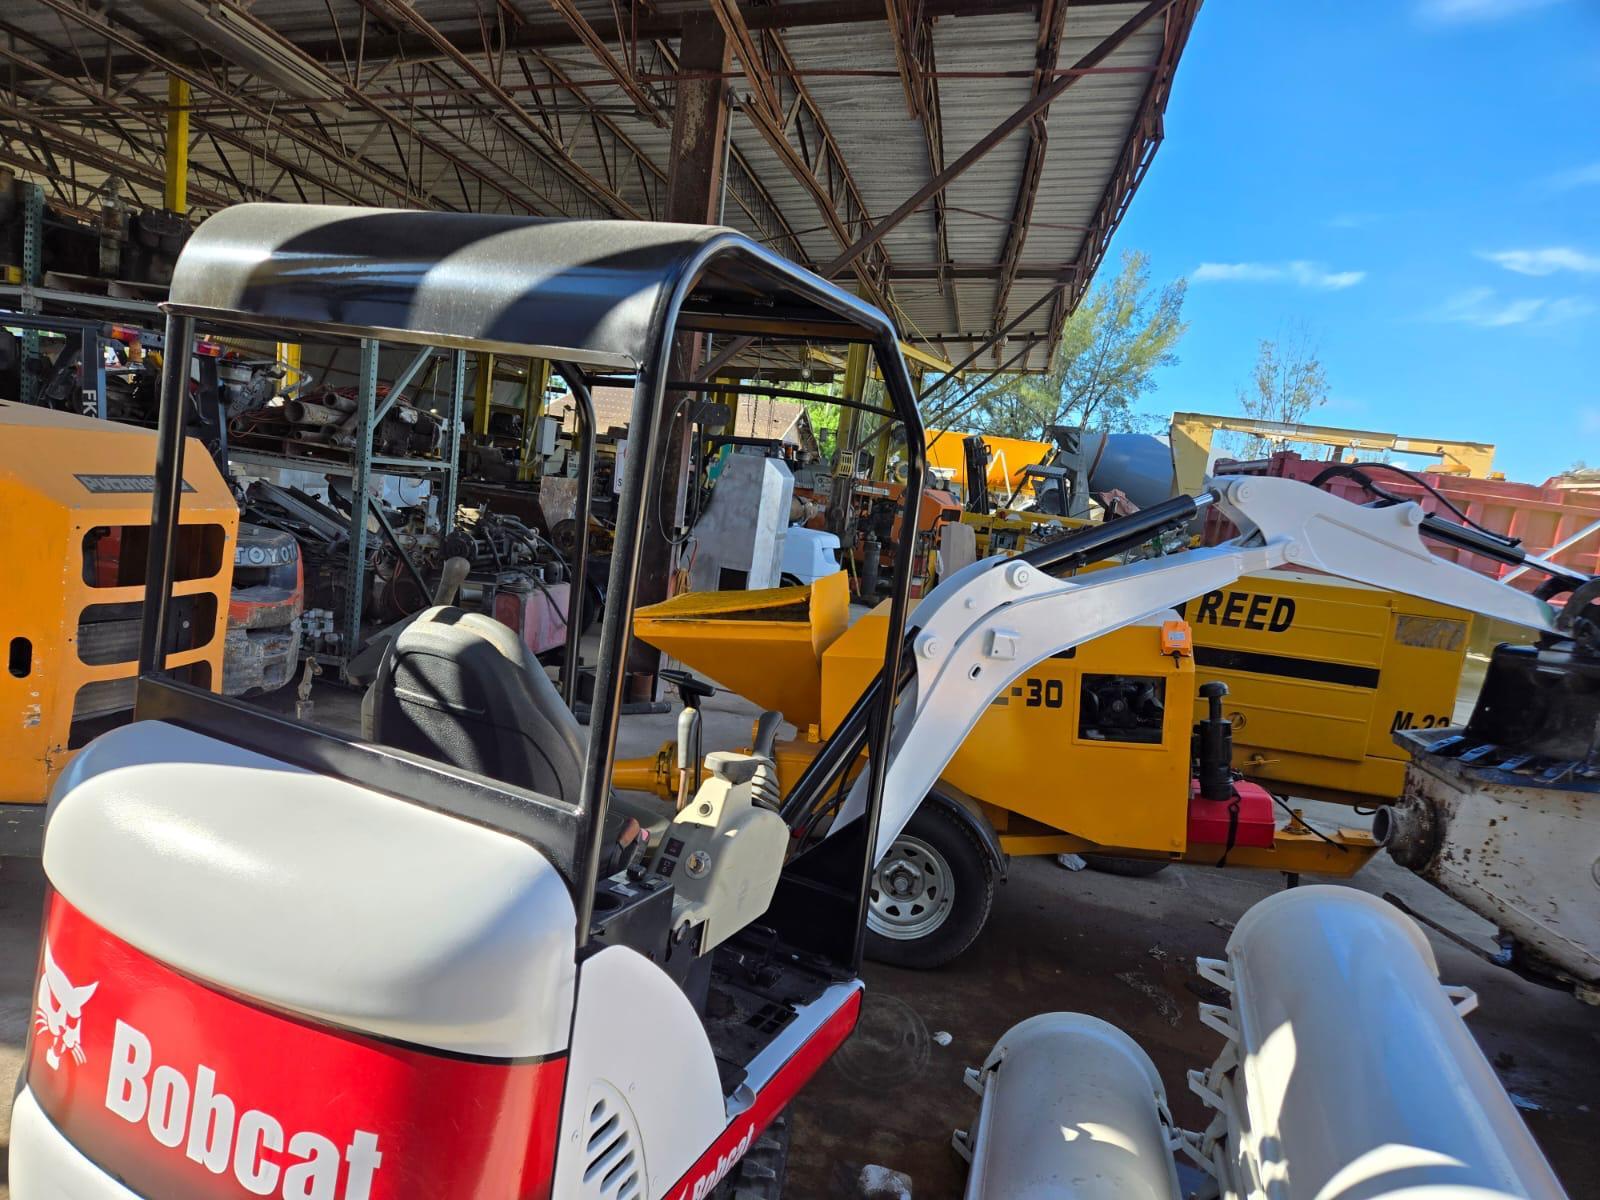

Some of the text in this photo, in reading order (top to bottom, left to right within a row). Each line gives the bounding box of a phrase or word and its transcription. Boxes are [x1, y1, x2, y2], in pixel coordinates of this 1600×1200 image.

[82, 389, 98, 418] FK
[235, 544, 298, 563] TOYOT
[1196, 589, 1296, 632] REED
[991, 678, 1063, 708] -30
[105, 1018, 382, 1200] Bobcat
